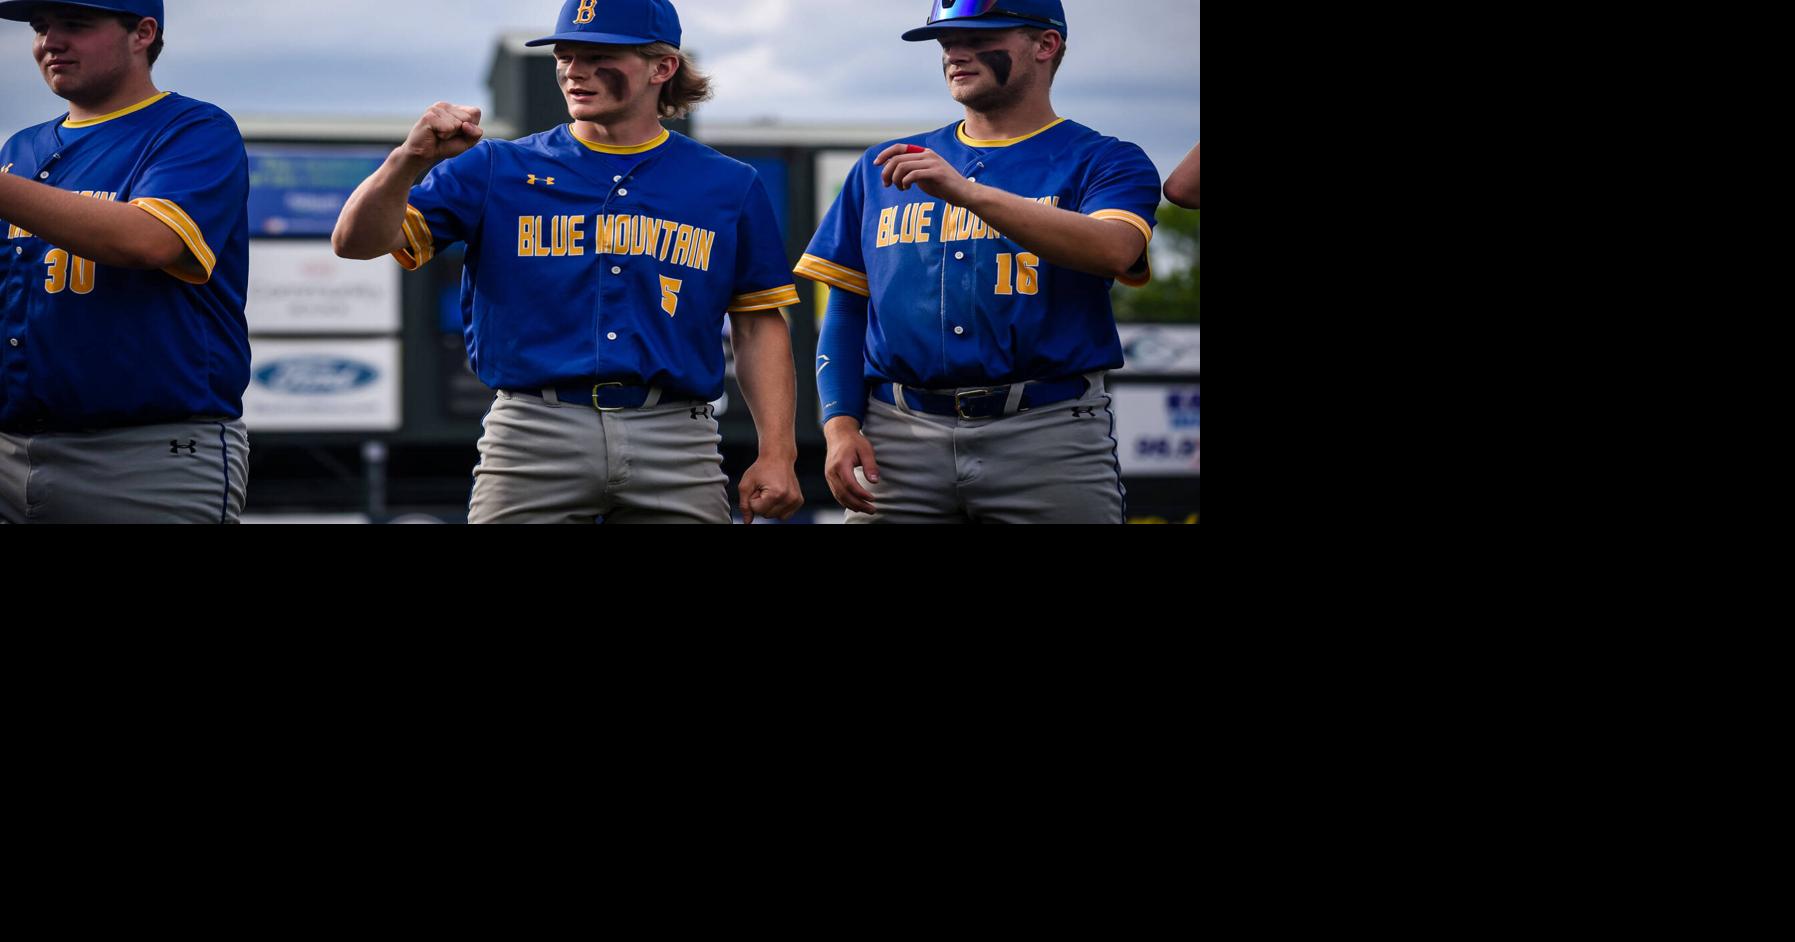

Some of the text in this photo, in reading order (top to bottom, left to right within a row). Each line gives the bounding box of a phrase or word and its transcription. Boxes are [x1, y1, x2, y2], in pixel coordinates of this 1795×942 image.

[572, 0, 597, 24] B
[518, 214, 716, 272] BLUE MOUNTAIN
[876, 202, 935, 248] BLUE
[659, 273, 683, 318] 5
[994, 252, 1040, 295] 16
